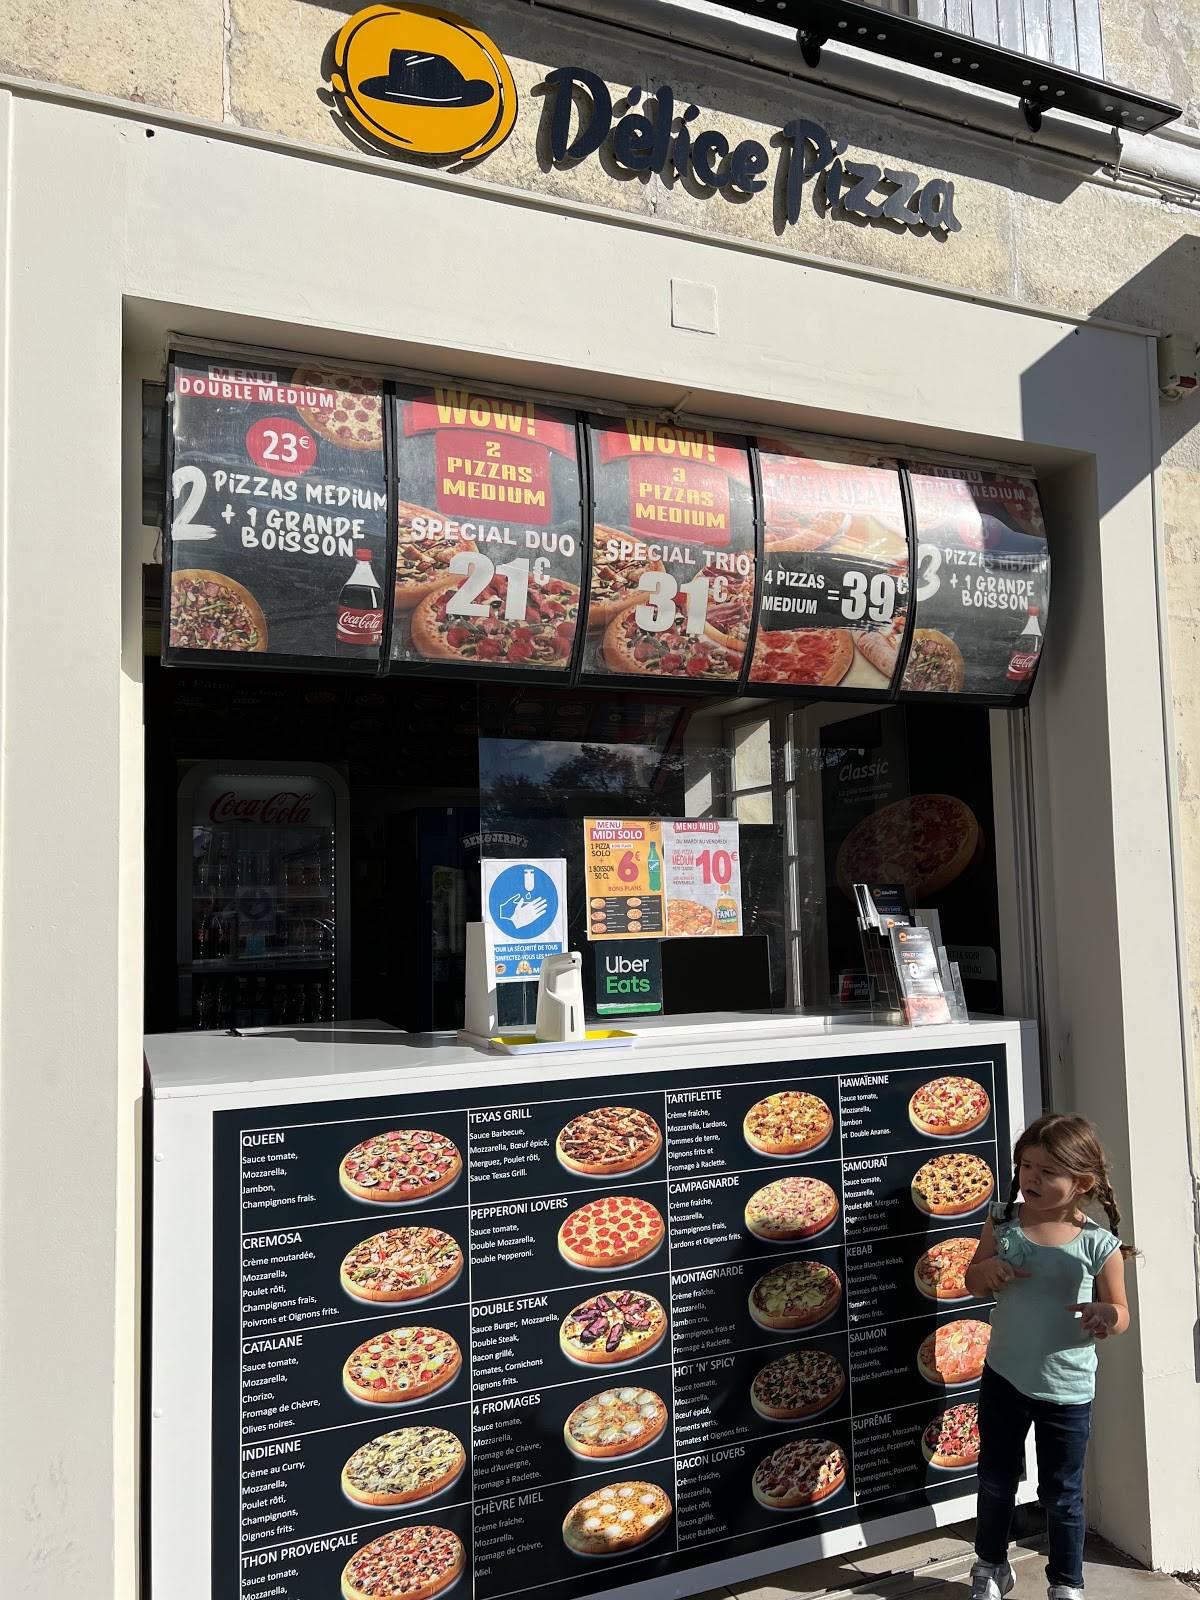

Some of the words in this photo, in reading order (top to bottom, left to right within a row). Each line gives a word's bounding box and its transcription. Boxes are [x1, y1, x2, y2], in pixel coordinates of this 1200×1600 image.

[545, 67, 769, 193] Délice
[783, 118, 962, 233] Pizza
[213, 368, 273, 384] MENU
[179, 377, 252, 400] DOUBLE
[258, 387, 334, 408] MEDIUM
[434, 388, 537, 437] WOW!
[262, 430, 310, 463] 23€
[625, 416, 716, 462] WOW!
[486, 441, 501, 458] 2
[447, 456, 533, 484] PIZZAS
[672, 467, 686, 483] 3
[936, 470, 979, 482] MENU
[443, 478, 545, 507] MEDIUM
[639, 482, 714, 507] PIZZAS
[172, 466, 217, 540] 2
[221, 504, 236, 525] +
[246, 507, 257, 527] 1
[266, 509, 365, 540] GRANDE
[635, 503, 725, 529] MEDIUM
[410, 516, 517, 546] SPECIAL
[525, 530, 575, 558] DUO
[606, 540, 696, 565] SPECIAL
[702, 550, 750, 576] TRIO
[763, 569, 773, 585] 4
[777, 571, 825, 589] PIZZAS
[917, 543, 942, 602] 3
[446, 551, 551, 620] 21€
[950, 573, 958, 589] +
[964, 575, 971, 589] 1
[976, 576, 1035, 597] GRANDE
[635, 571, 729, 635] 31€
[761, 595, 817, 615] MEDIUM
[838, 759, 890, 783] Classic
[209, 791, 317, 824] Coca-Cola
[593, 831, 615, 840] MIDI
[617, 830, 642, 839] SOLO
[676, 822, 697, 831] MENU
[700, 822, 716, 831] MIDI
[617, 851, 640, 882] 6€
[696, 850, 738, 885] 10€
[717, 909, 736, 918] FANTA
[606, 956, 649, 973] Uber
[607, 976, 650, 994] Eats
[840, 1075, 889, 1088] HAWAÏENNE
[667, 1090, 722, 1104] TARTIFLETTE
[470, 1111, 502, 1124] TEXAS
[503, 1108, 532, 1120] GRILL
[667, 1111, 686, 1119] Crème
[242, 1133, 285, 1147] QUEEN
[469, 1132, 490, 1141] Sauce
[491, 1128, 525, 1138] Barbecue,
[850, 1130, 869, 1138] Double
[242, 1154, 266, 1164] Sauce
[470, 1157, 502, 1169] Merguez,
[503, 1155, 525, 1164] Poulet
[843, 1156, 888, 1171] SAMOURAÏ
[470, 1173, 490, 1183] Sauce
[492, 1171, 510, 1180] Texas
[669, 1176, 740, 1194] CAMPAGNARDE
[242, 1197, 296, 1209] Champignons
[470, 1202, 528, 1220] PEPPERONI
[530, 1198, 568, 1212] LOVERS
[670, 1202, 689, 1210] Crème
[470, 1228, 491, 1237] Sauce
[492, 1224, 520, 1235] tomate,
[670, 1224, 711, 1235] Champignons
[242, 1232, 302, 1250] CREMOSA
[471, 1241, 496, 1250] Double
[497, 1236, 536, 1246] Mozzarella,
[671, 1240, 694, 1249] Lardons
[704, 1236, 727, 1245] Oignons
[471, 1255, 496, 1265] Double
[497, 1250, 534, 1262] Pepperoni.
[846, 1245, 873, 1257] KEBAB
[242, 1257, 269, 1267] Crème
[672, 1265, 744, 1285] MONTAGNARDE
[242, 1287, 268, 1297] Poulet
[242, 1299, 296, 1313] Champignons
[472, 1301, 514, 1318] DOUBLE
[517, 1296, 548, 1310] STEAK
[472, 1325, 492, 1334] Sauce
[494, 1321, 518, 1331] Burger,
[521, 1313, 560, 1326] Mozzarella,
[472, 1339, 497, 1349] Double
[499, 1335, 519, 1345] Steak,
[849, 1328, 887, 1343] SAUMON
[242, 1335, 303, 1355] CATALANE
[472, 1353, 494, 1363] Bacon
[242, 1363, 266, 1373] Sauce
[473, 1366, 503, 1377] Tomates,
[505, 1358, 543, 1371] Cornichons
[674, 1365, 693, 1377] HOT
[711, 1357, 735, 1370] SPICY
[473, 1380, 501, 1392] Oignons
[242, 1406, 278, 1420] Fromage
[473, 1405, 480, 1415] 4
[482, 1394, 541, 1414] FROMAGES
[473, 1423, 494, 1433] Sauce
[853, 1413, 892, 1430] SUPRÊME
[242, 1440, 301, 1462] INDIENNE
[474, 1450, 505, 1462] Fromage
[677, 1455, 709, 1471] BACON
[712, 1447, 745, 1462] LOVERS
[242, 1468, 269, 1480] Crème
[242, 1498, 268, 1511] Poulet
[474, 1497, 517, 1516] CHÈVRE
[519, 1492, 544, 1506] MIEL
[242, 1551, 277, 1569] THON
[281, 1533, 358, 1560] PROVENÇALE
[242, 1576, 265, 1587] Sauce
